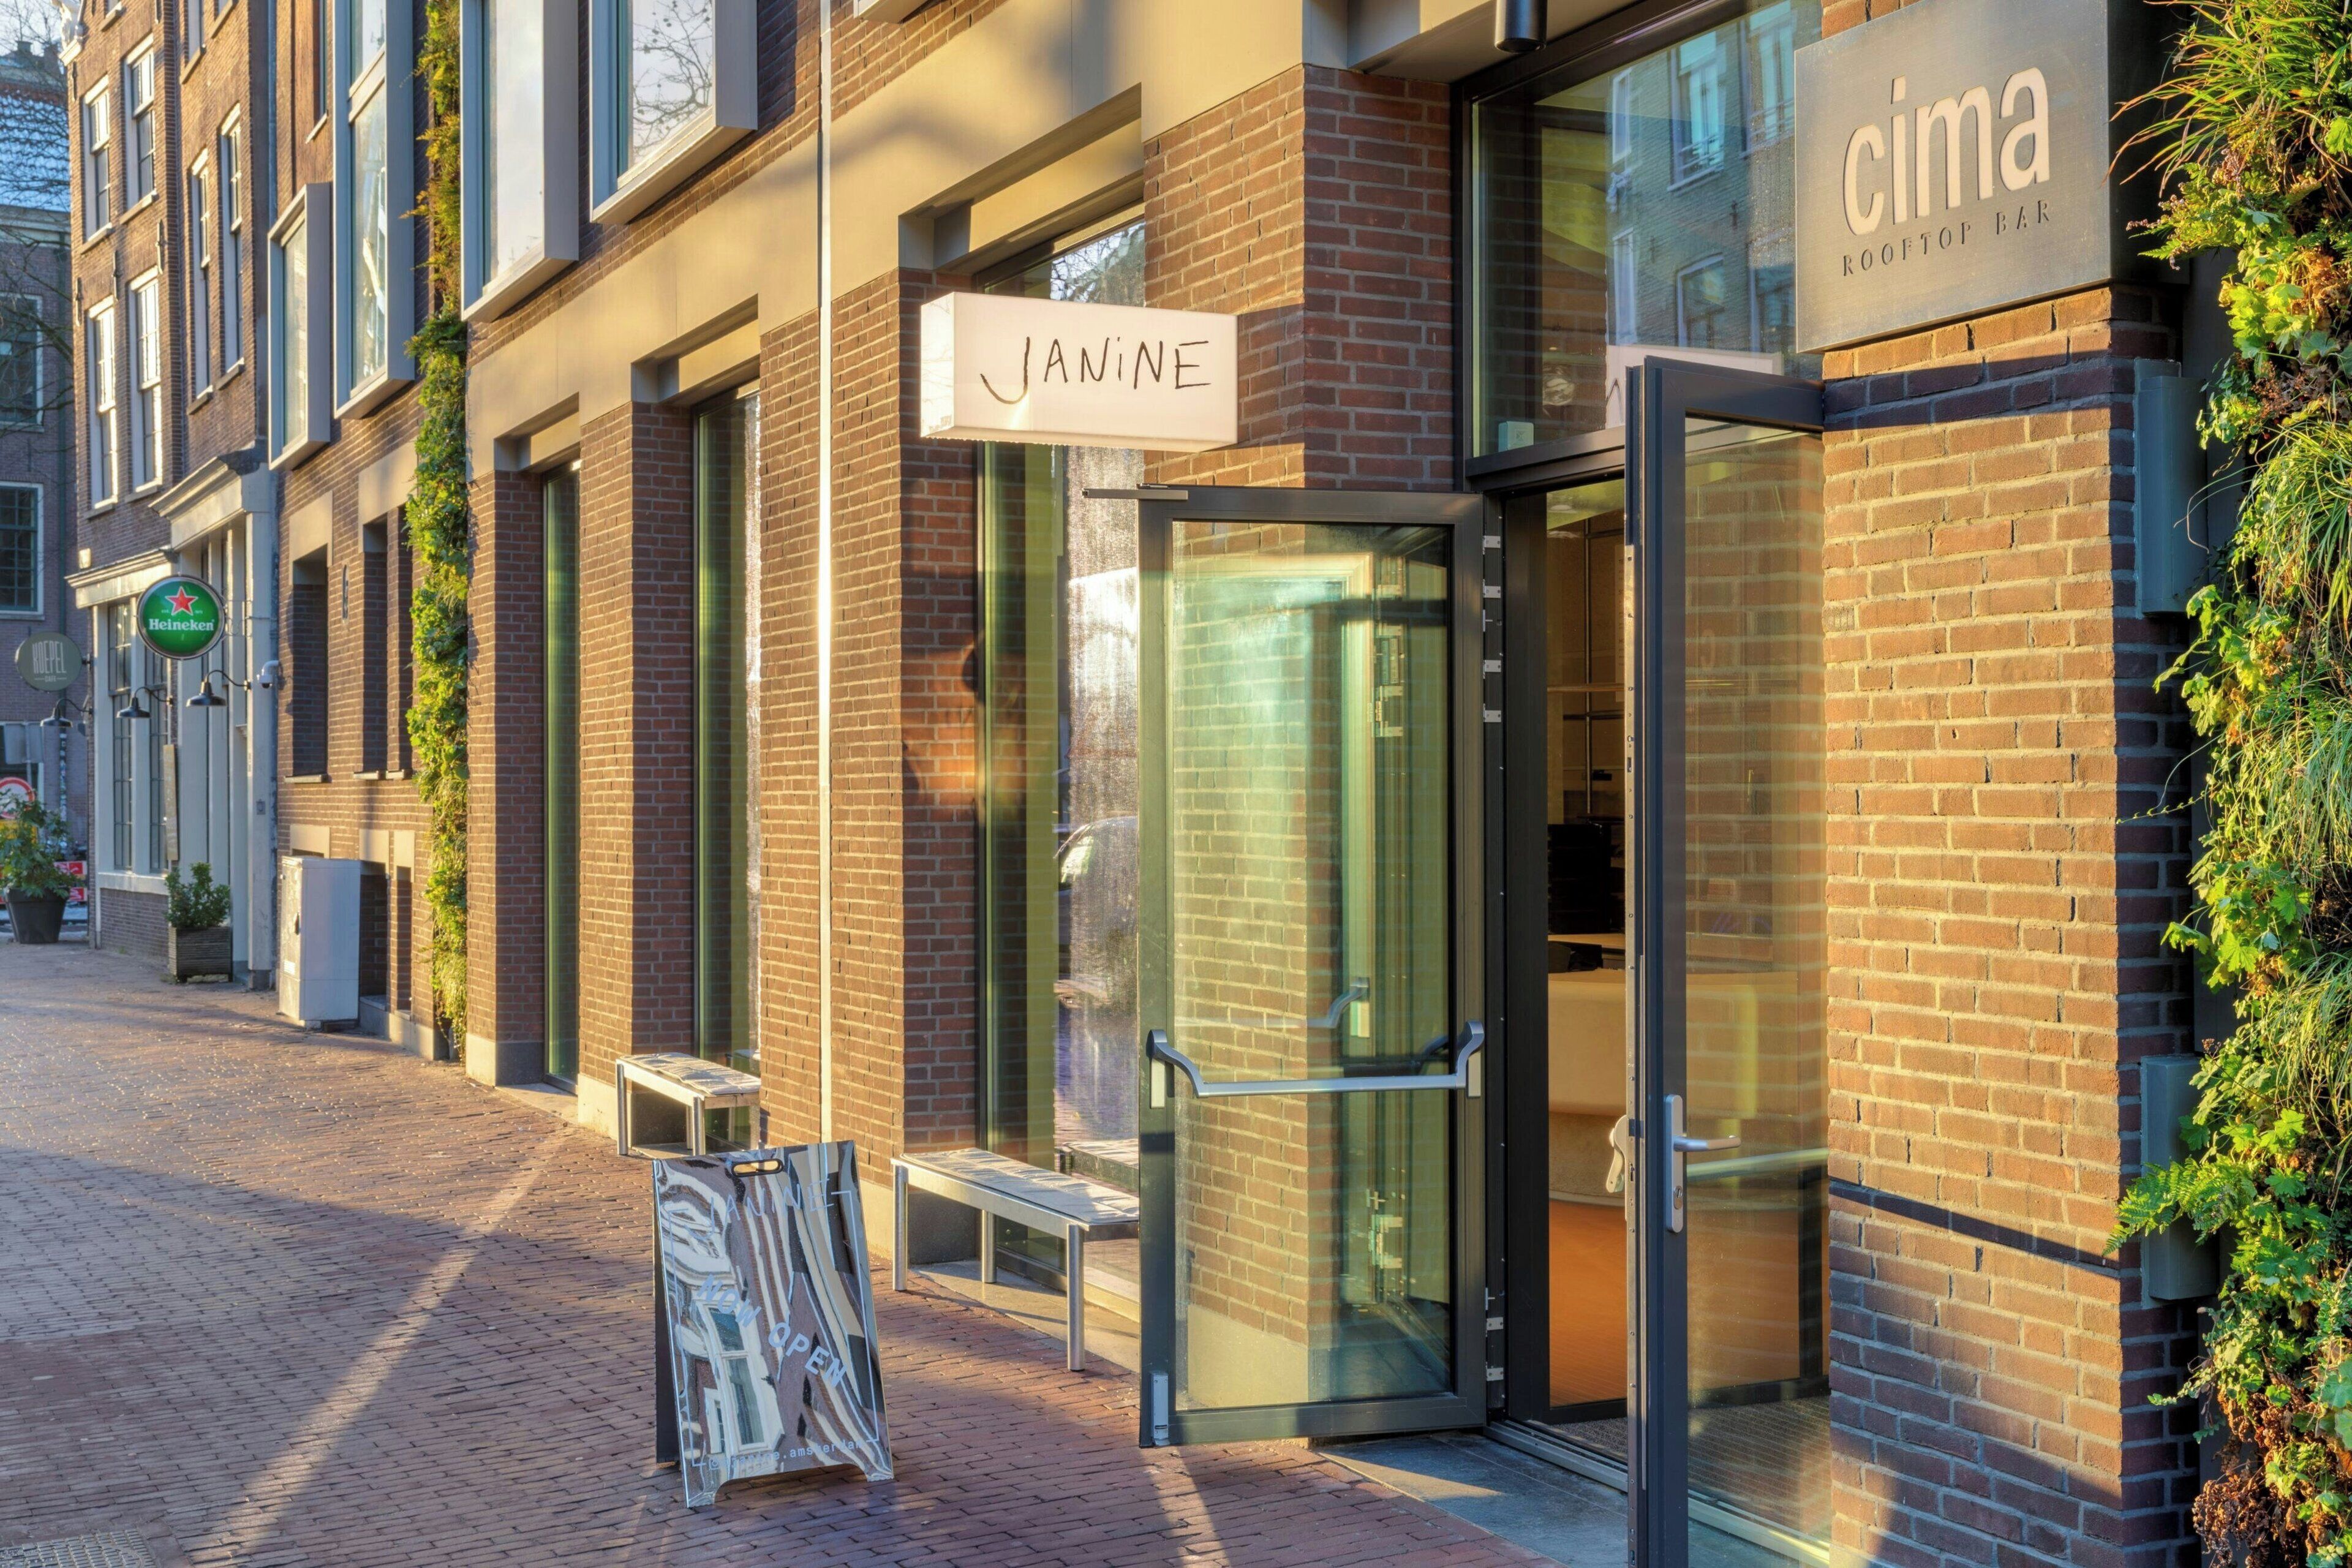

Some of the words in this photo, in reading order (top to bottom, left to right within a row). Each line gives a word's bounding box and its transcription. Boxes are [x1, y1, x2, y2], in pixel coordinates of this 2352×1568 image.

[1843, 67, 2049, 236] cima
[1843, 221, 1971, 277] ROOFTOP
[1996, 200, 2049, 235] BAR
[149, 619, 214, 631] Heineken
[696, 1273, 762, 1328] NOW
[768, 1322, 847, 1388] OPEN
